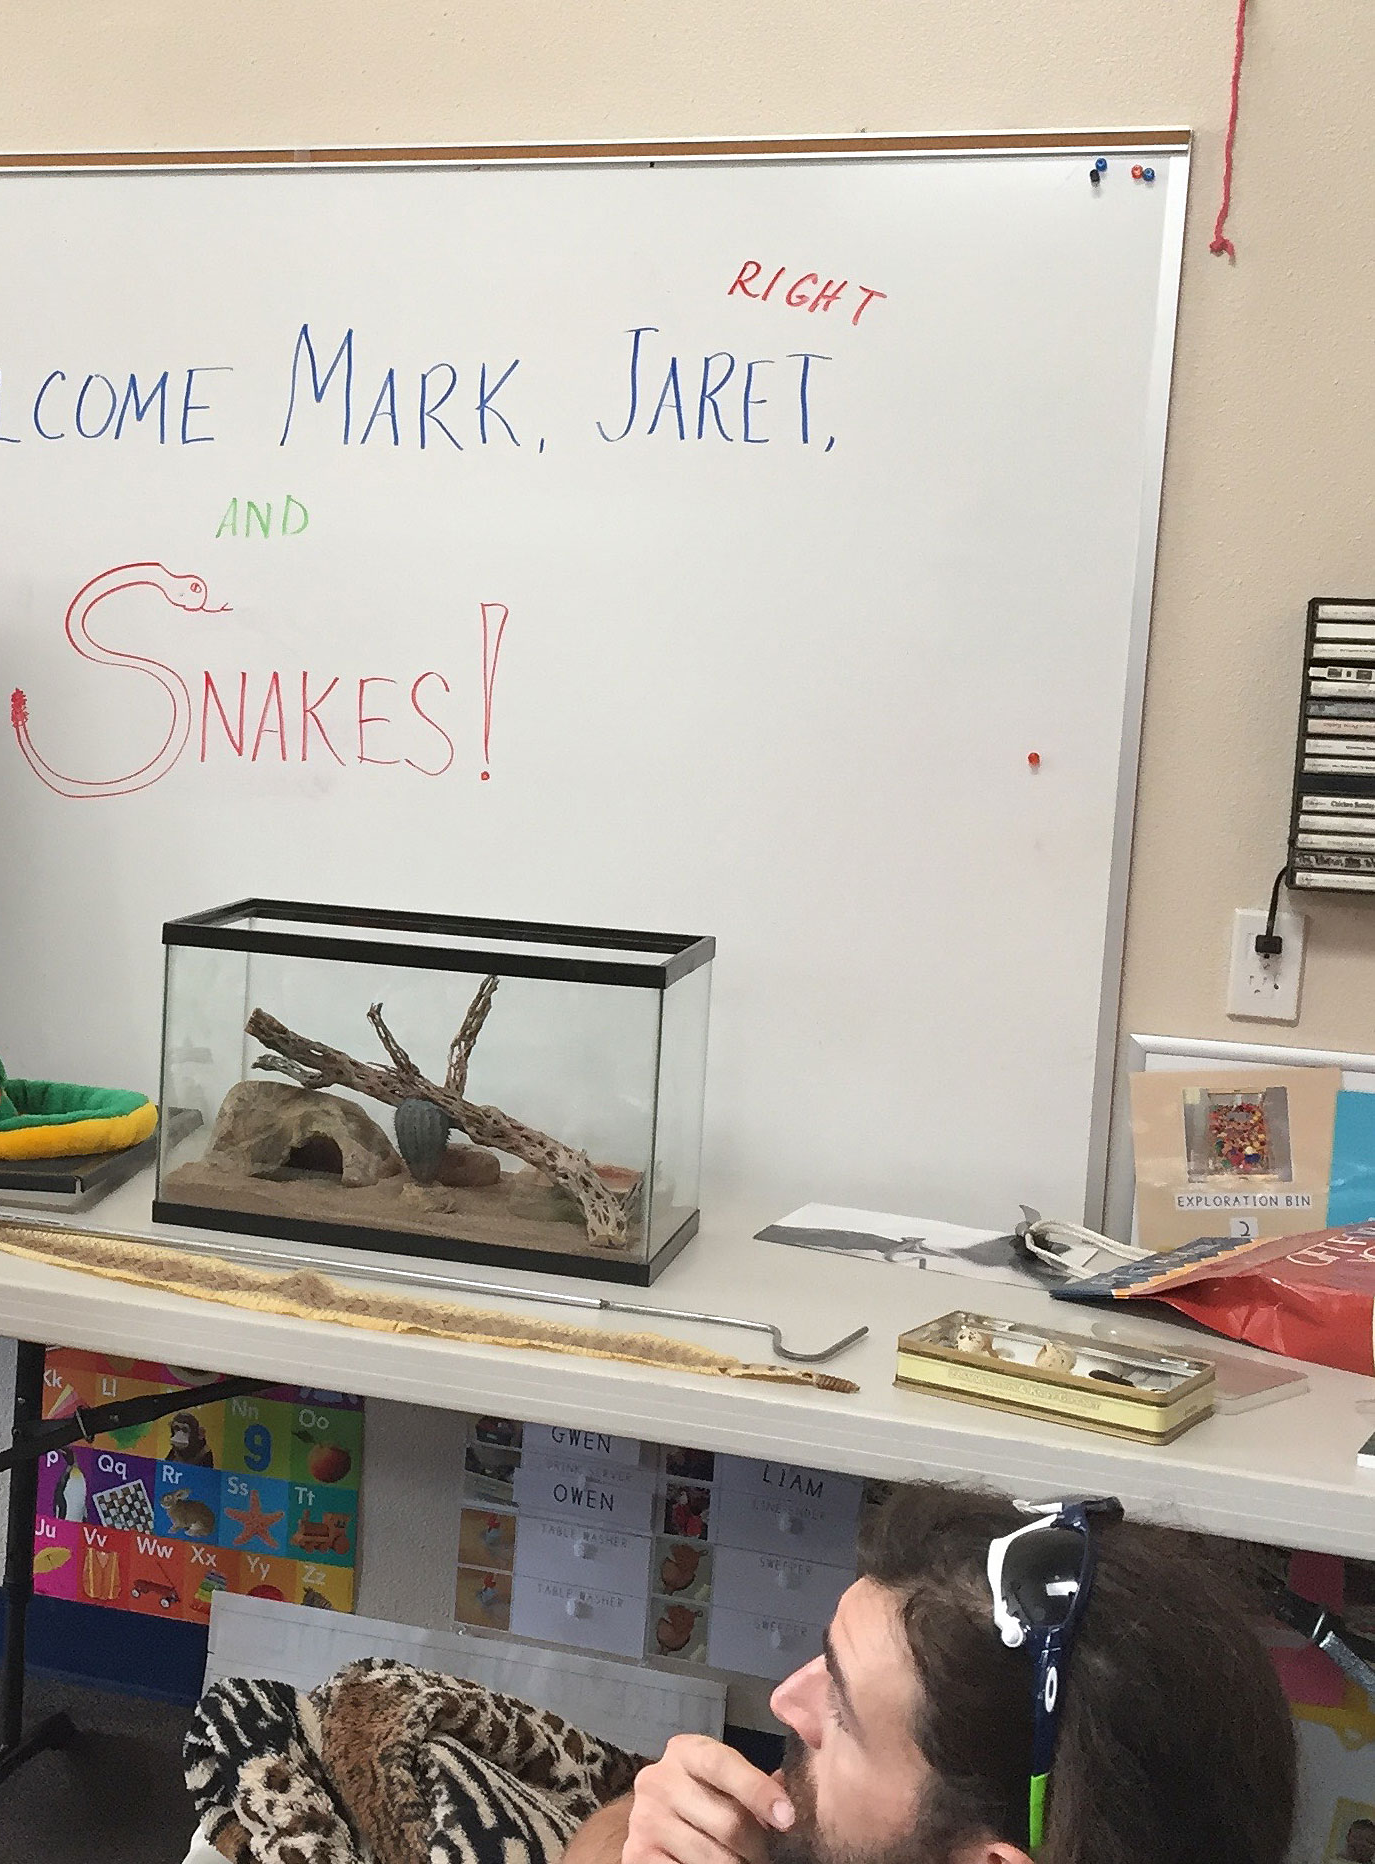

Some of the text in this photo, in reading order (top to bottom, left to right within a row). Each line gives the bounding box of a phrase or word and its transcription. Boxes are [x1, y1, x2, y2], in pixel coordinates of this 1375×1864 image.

[727, 260, 887, 326] RIGHT
[281, 323, 544, 453] MARK,
[596, 326, 835, 452] JARET,
[216, 495, 309, 539] AND
[1177, 1195, 1311, 1207] EXPLORATION BIN
[1239, 1221, 1251, 1237] 2
[232, 1400, 259, 1420] Nn
[299, 1409, 330, 1430] Oo
[243, 1424, 272, 1472] 9
[551, 1426, 611, 1453] GWEN
[97, 1454, 127, 1480] Qq
[162, 1464, 183, 1484] Rr
[227, 1476, 249, 1496] Ss
[295, 1486, 315, 1506] Tt
[762, 1463, 824, 1498] LIAM
[553, 1483, 614, 1511] OWEN
[541, 1523, 628, 1549] TABLE WASHER
[83, 1526, 108, 1547] Vv
[136, 1536, 174, 1559] Ww
[190, 1545, 217, 1567] Xx
[247, 1555, 271, 1581] Yy
[301, 1564, 327, 1585] Zz
[537, 1583, 573, 1599] TABLE
